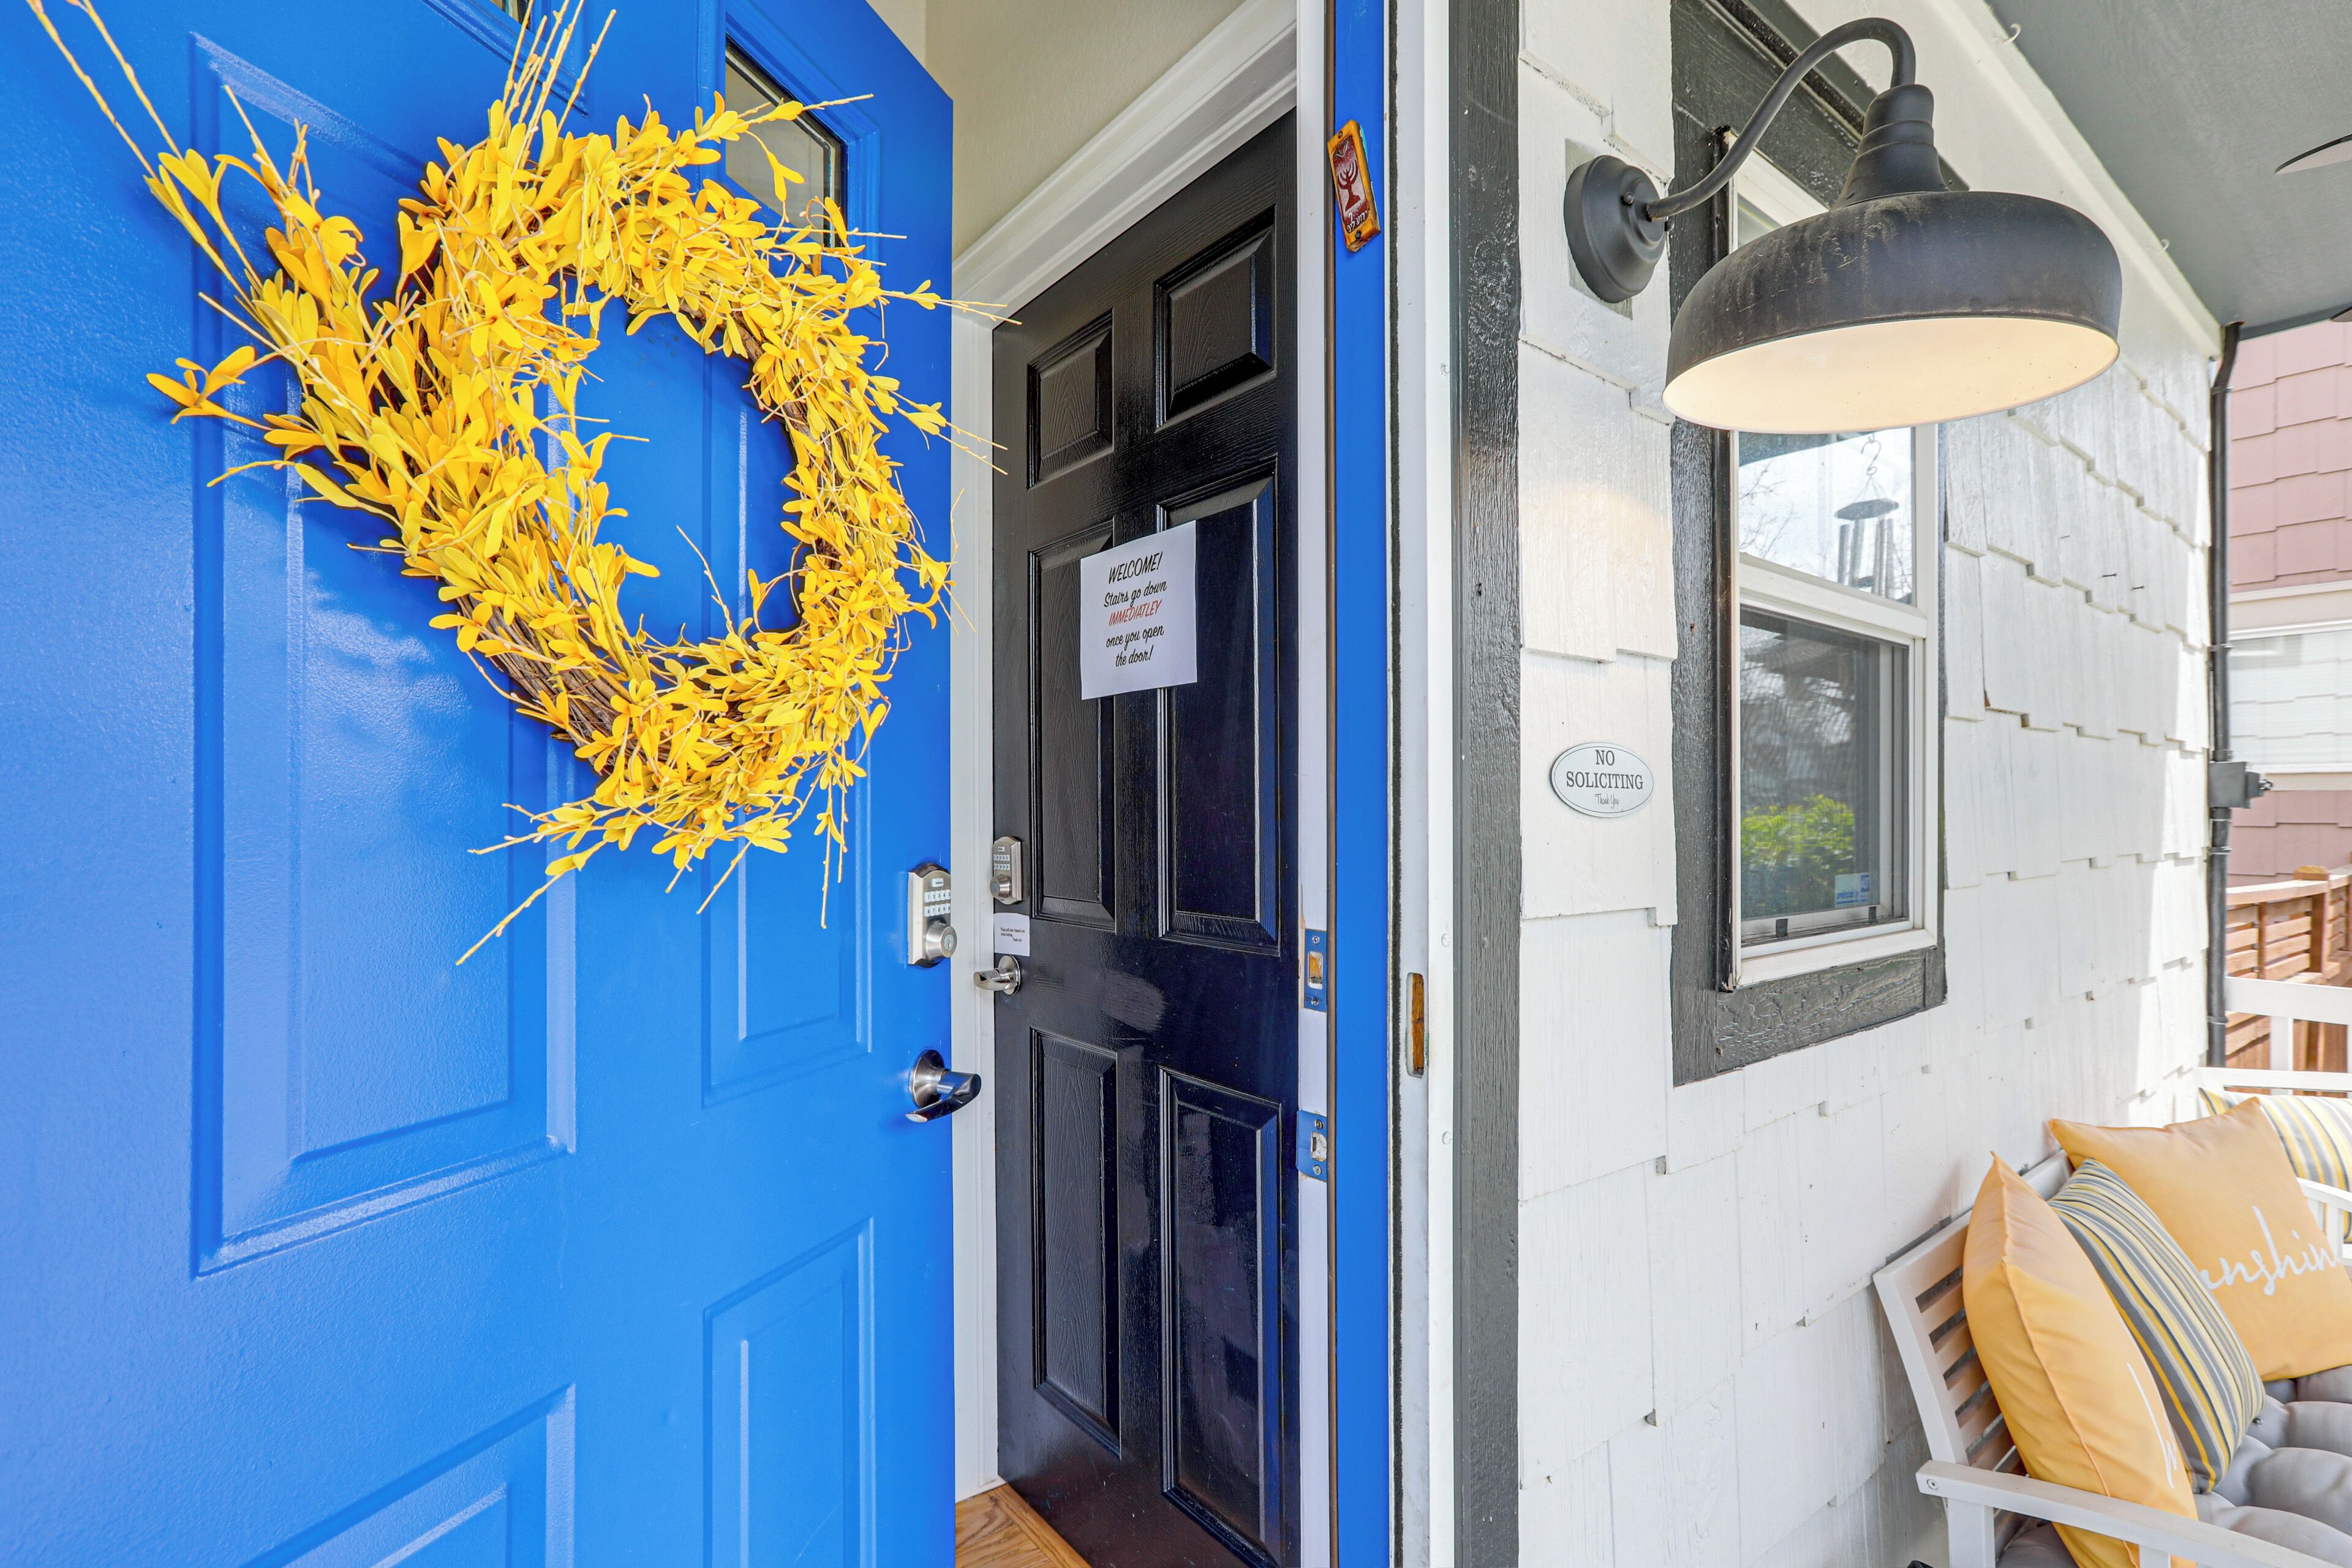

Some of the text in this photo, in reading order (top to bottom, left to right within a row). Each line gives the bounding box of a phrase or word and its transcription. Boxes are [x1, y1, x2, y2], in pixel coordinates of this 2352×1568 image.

[1109, 551, 1163, 584] WELCOME!
[1103, 581, 1167, 608] Stairs go down
[1109, 599, 1163, 627] IMMEDIATLEY
[1106, 625, 1164, 650] once you open
[1115, 644, 1154, 667] the door!
[1595, 749, 1615, 766] NO
[1566, 771, 1644, 790] SOLICITING
[1595, 793, 1619, 809] Thank You
[2199, 1205, 2340, 1295] nshin
